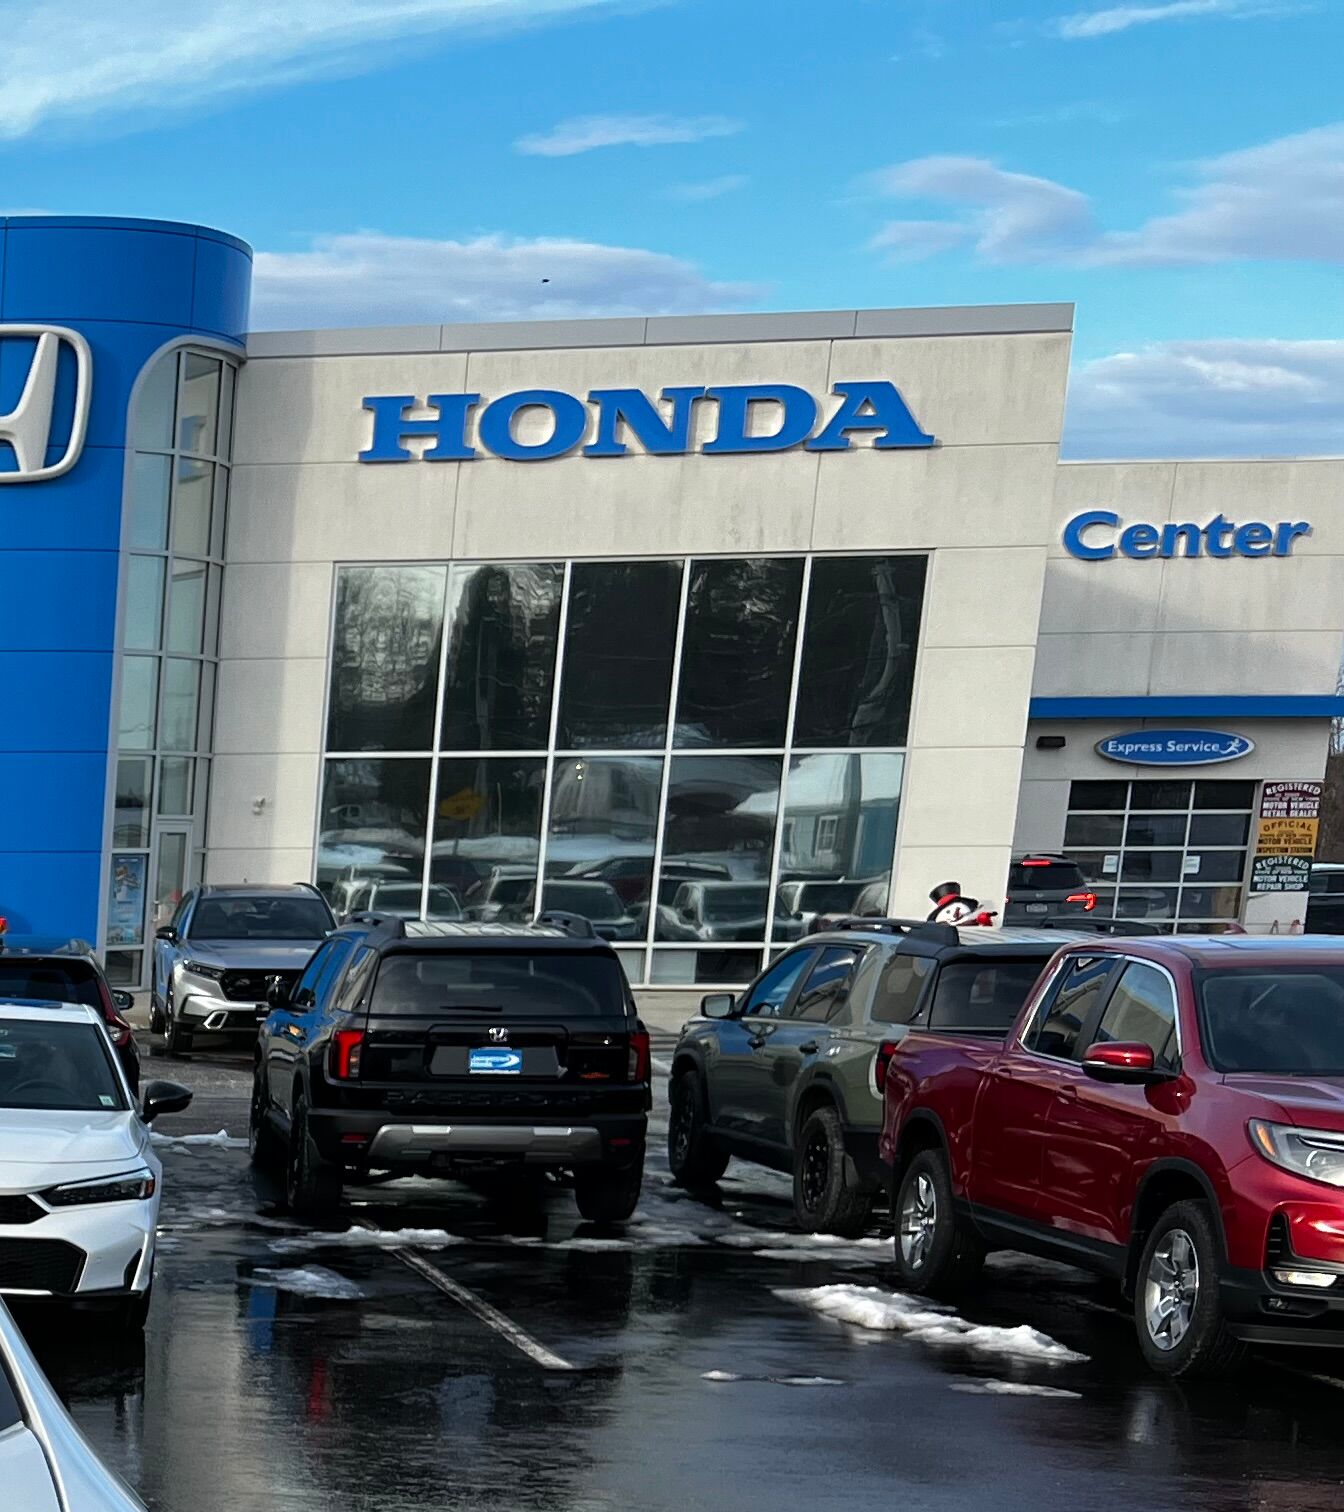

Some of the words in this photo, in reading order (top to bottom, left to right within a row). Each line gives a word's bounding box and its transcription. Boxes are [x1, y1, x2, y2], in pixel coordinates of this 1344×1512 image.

[358, 380, 936, 463] HONDA
[1063, 510, 1311, 561] Center
[1107, 740, 1162, 755] Express
[1167, 740, 1220, 752] Service
[1265, 783, 1321, 796] REGISTERED
[1262, 801, 1287, 809] MOTOR
[1290, 801, 1320, 809] VEHICLE
[1263, 820, 1313, 832] OFFICIAL
[1255, 856, 1310, 870] REGISTERED
[1279, 875, 1308, 883] VEHICLE
